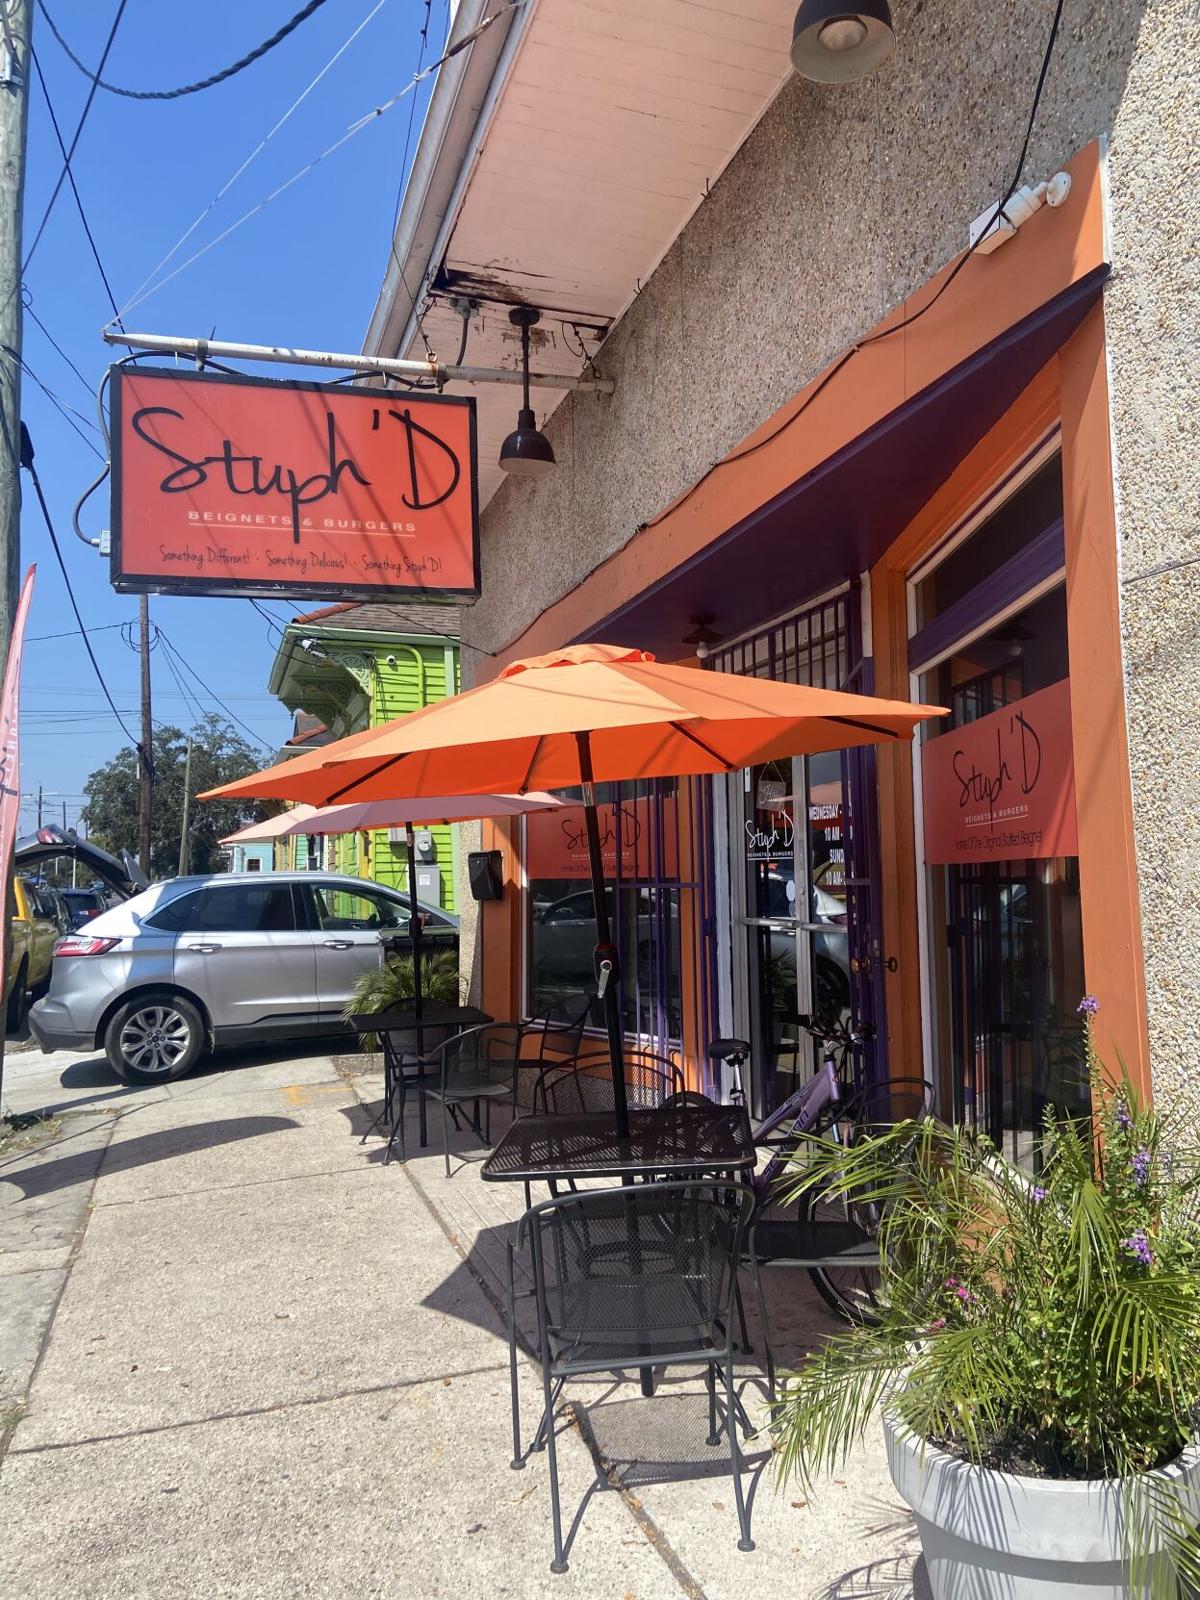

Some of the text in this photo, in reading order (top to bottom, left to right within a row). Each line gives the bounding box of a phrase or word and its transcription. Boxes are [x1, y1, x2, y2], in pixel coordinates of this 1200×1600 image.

[187, 510, 416, 532] BEIGNETS & BURGERS
[159, 544, 203, 570] Something
[206, 545, 250, 565] Different!
[265, 549, 307, 574] Something
[310, 551, 347, 570] Delicious!
[361, 554, 402, 578] Something
[808, 804, 839, 821] WEDNESDAY
[965, 812, 992, 823] BEIGNETS
[999, 804, 1029, 817] BURGERS
[824, 827, 832, 841] 10
[832, 826, 840, 841] AM
[830, 848, 845, 864] SUND
